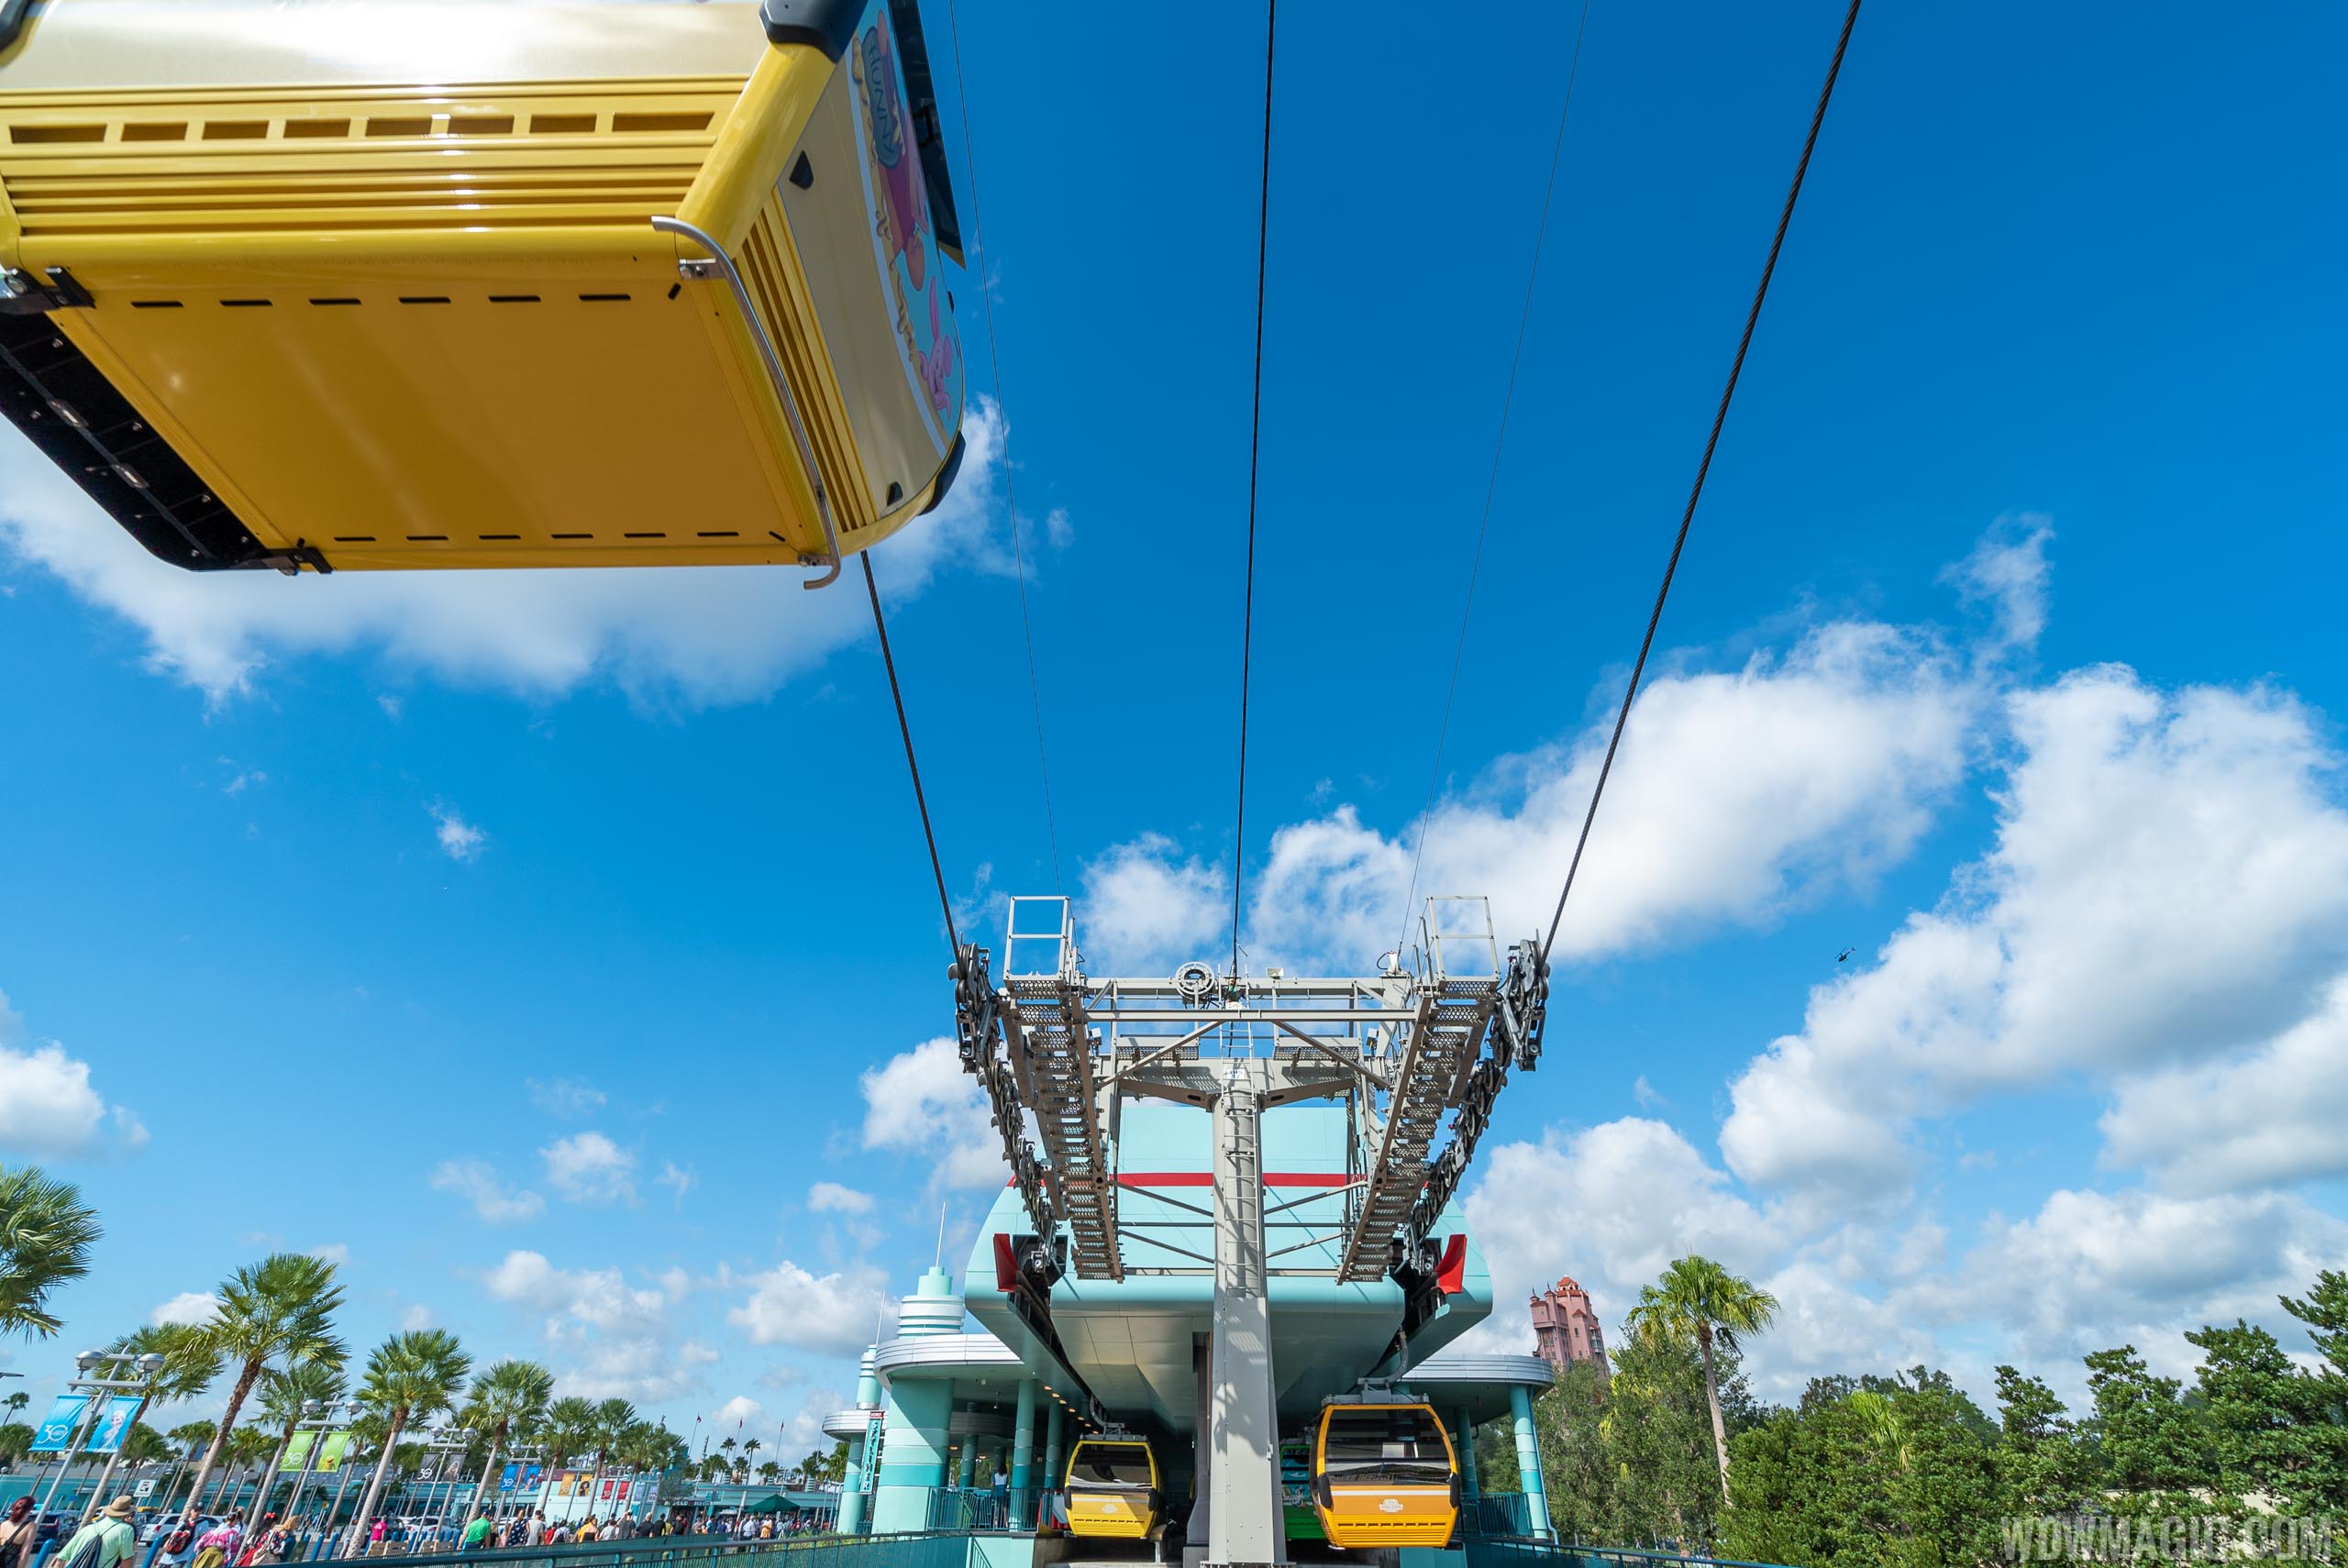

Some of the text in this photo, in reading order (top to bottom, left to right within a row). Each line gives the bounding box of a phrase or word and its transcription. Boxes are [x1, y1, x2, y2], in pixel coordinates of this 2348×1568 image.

[869, 43, 895, 154] HUNNY
[37, 1424, 69, 1444] 30
[416, 1468, 433, 1481] 30
